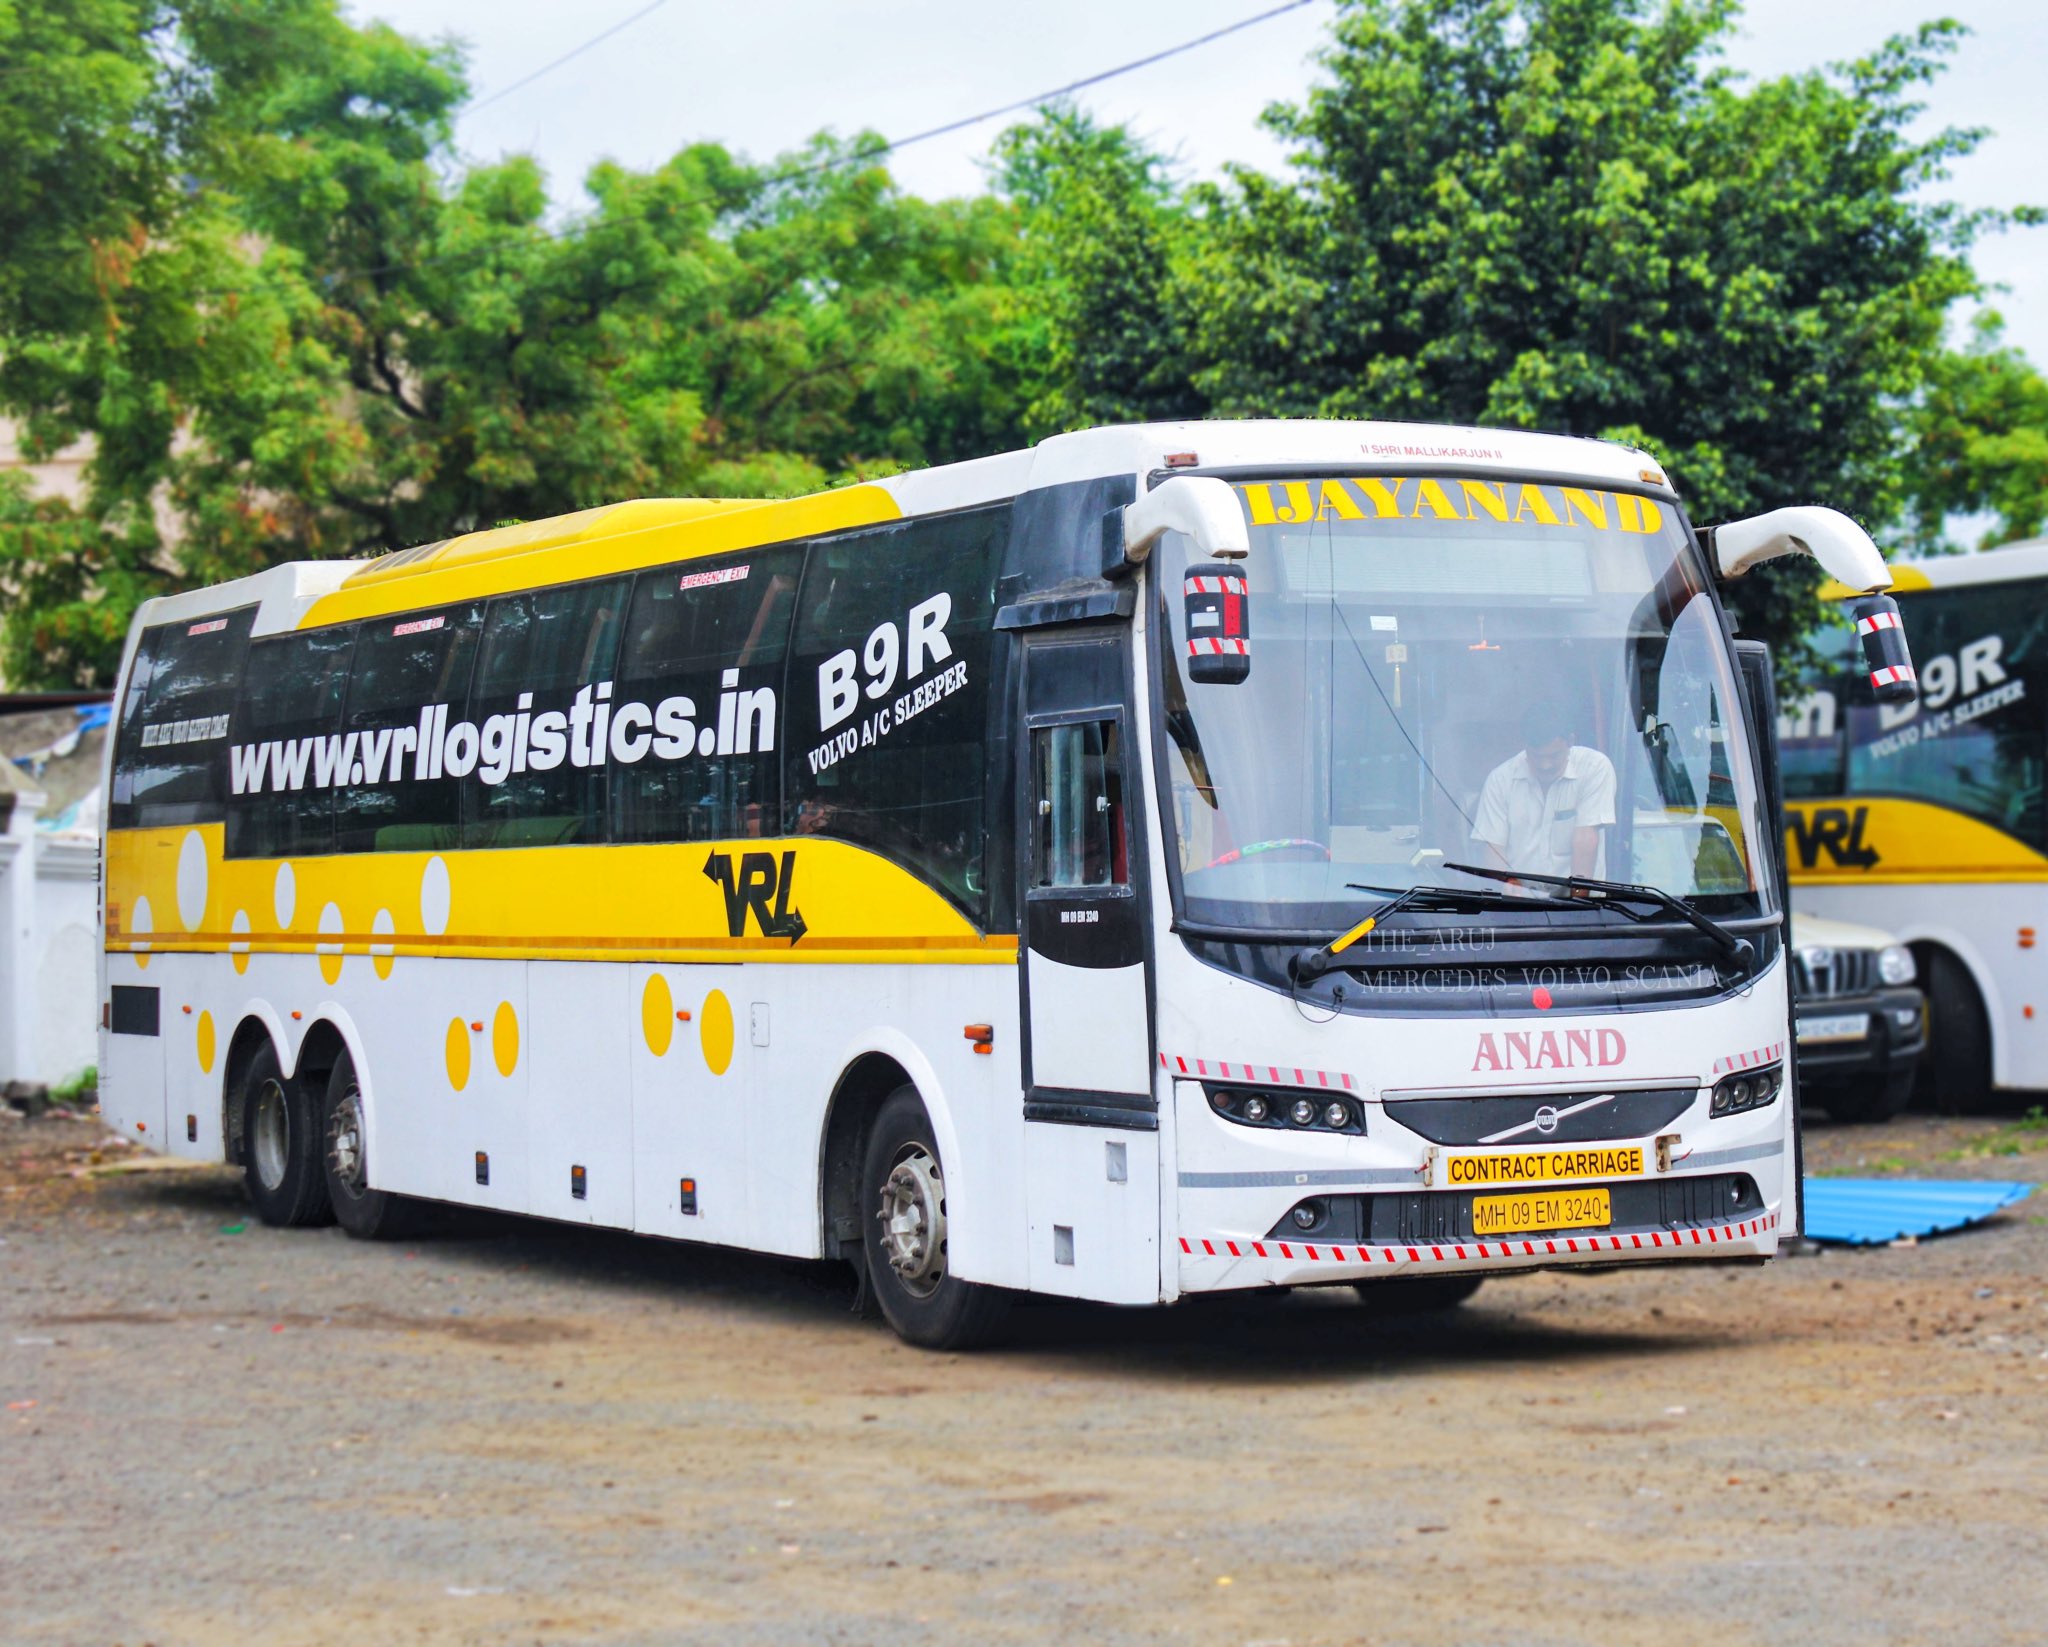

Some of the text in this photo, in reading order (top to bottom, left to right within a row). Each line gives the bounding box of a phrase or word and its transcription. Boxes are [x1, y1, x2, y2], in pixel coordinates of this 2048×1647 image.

[1371, 445, 1402, 455] SHRI
[1404, 446, 1492, 459] MALLIKARJUN
[1232, 477, 1662, 534] IJAYANAND
[681, 565, 749, 589] EMERGENCY EXIT
[818, 592, 953, 732] B9R
[230, 668, 776, 795] www.vrllogistics.in
[808, 660, 968, 775] VOLVO A/C SLEEPER
[703, 849, 808, 946] VRL
[1471, 1028, 1627, 1071] ANAND
[1451, 1150, 1640, 1181] CONTRACT CARRIAGE
[1480, 1196, 1601, 1227] MH 09 EM 3240
